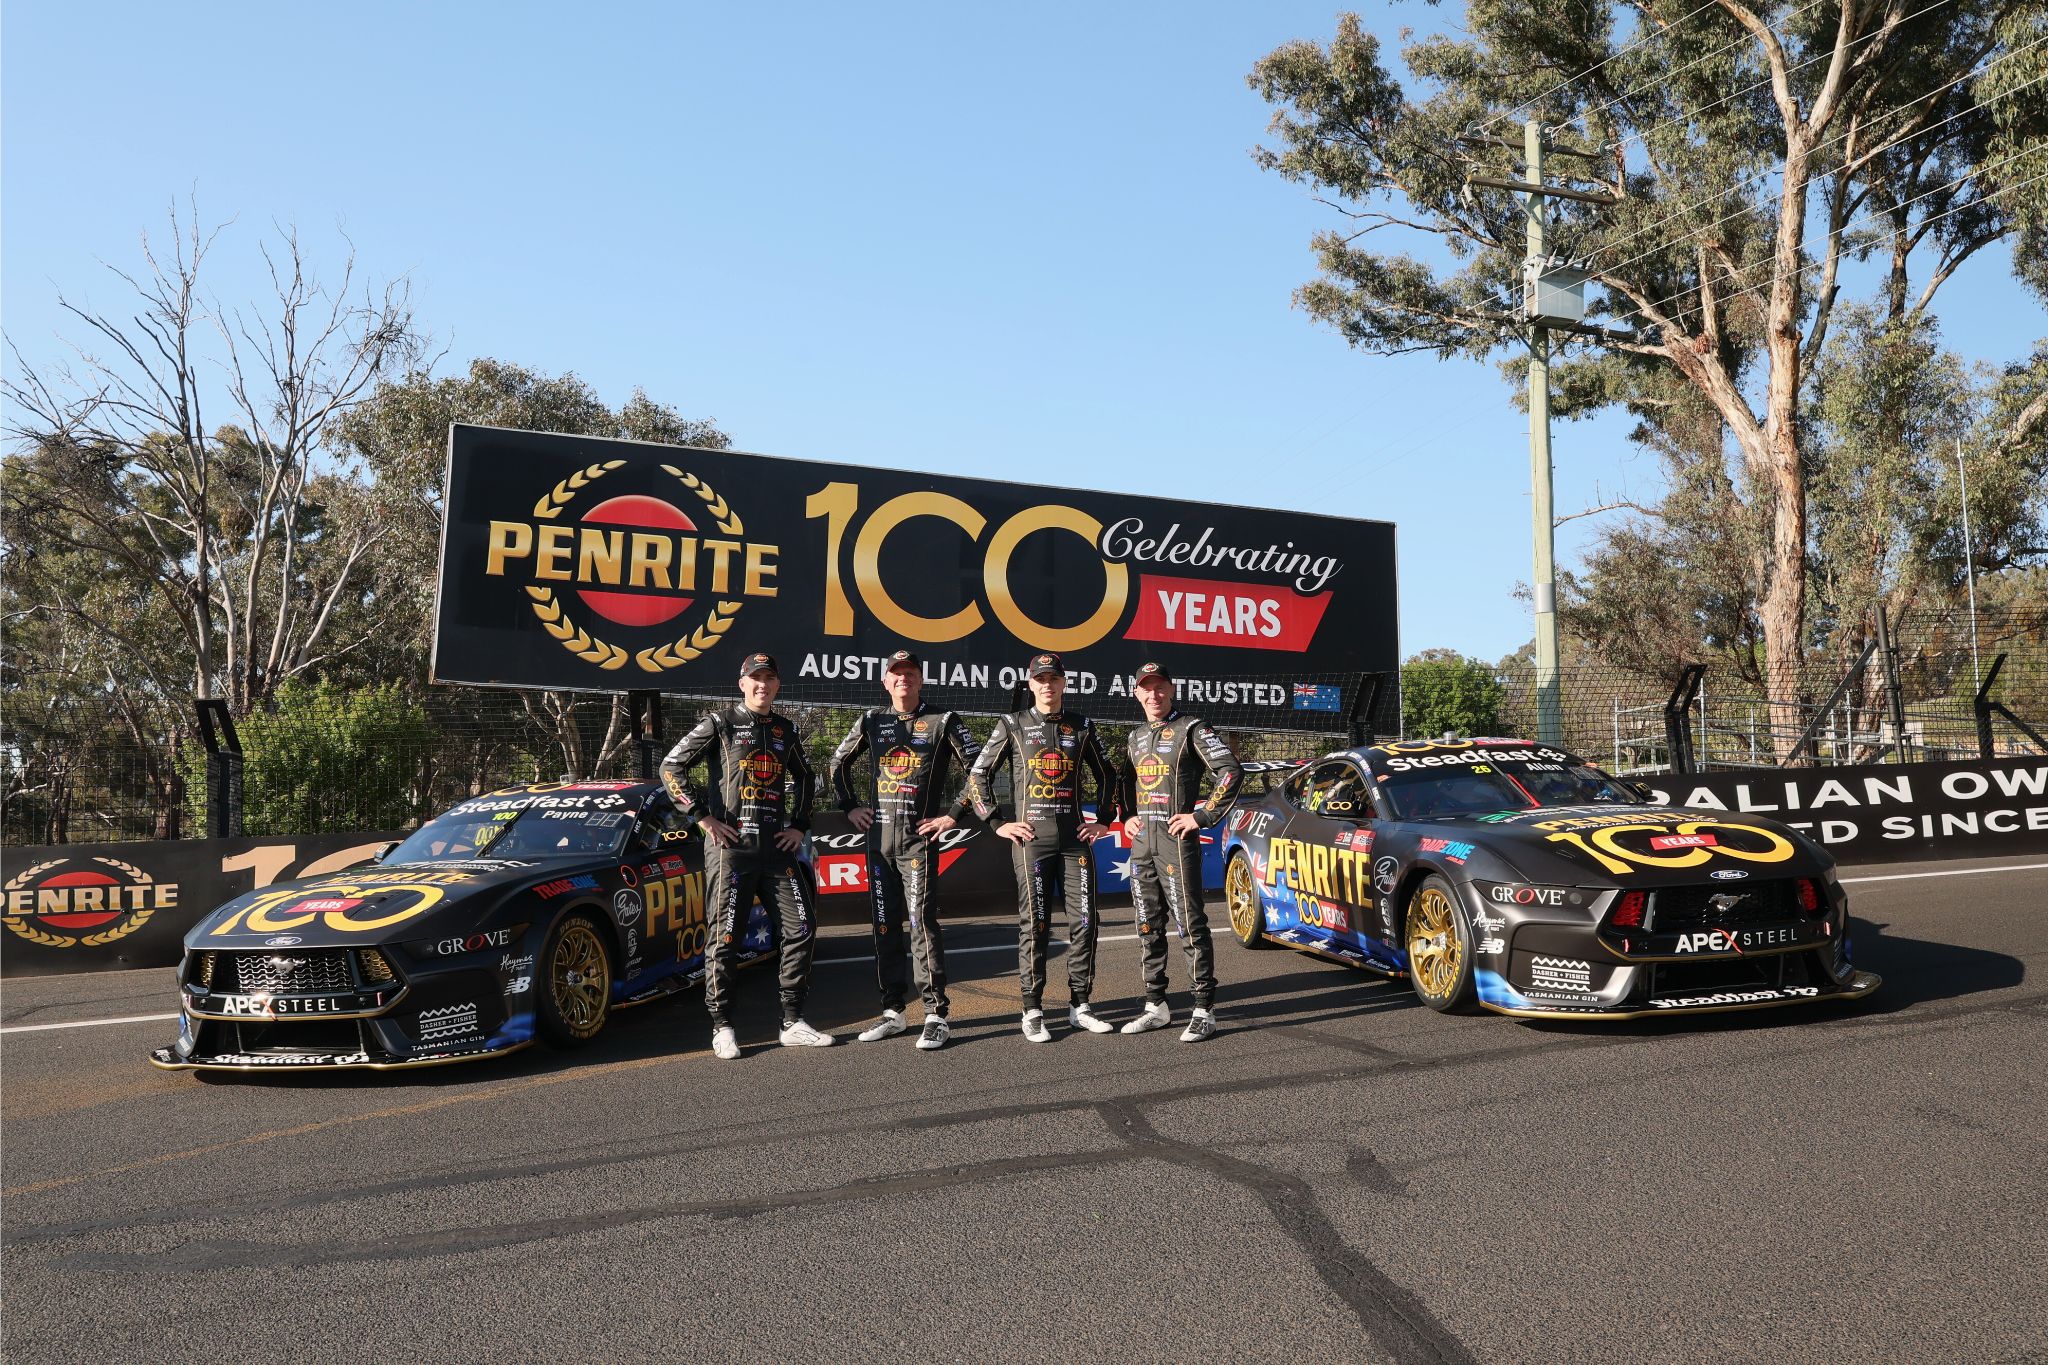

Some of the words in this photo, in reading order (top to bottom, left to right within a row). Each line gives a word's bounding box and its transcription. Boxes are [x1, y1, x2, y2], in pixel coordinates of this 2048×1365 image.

[485, 520, 779, 597] PENRITE
[1102, 517, 1343, 592] Celebrating
[806, 481, 1129, 652] 100
[1157, 590, 1282, 638] YEARS
[799, 653, 988, 688] AUSTLIAN
[998, 666, 1098, 695] OED
[1172, 677, 1286, 706] TRUSTED
[879, 756, 922, 768] PENRITE
[1027, 758, 1074, 771] PENRITE
[1386, 749, 1540, 772] Steadfast
[1471, 765, 1492, 774] 26
[1525, 762, 1564, 771] Allen
[1309, 790, 1323, 812] 26
[1650, 776, 1913, 813] ALIAN
[450, 795, 592, 817] Steadfast
[492, 811, 518, 821] 100
[541, 810, 588, 821] Payne
[1326, 801, 1352, 811] 100
[1229, 809, 1272, 838] GROVE
[1565, 820, 1629, 832] AUSTRALIAN
[1881, 806, 2048, 840] SINCE
[661, 830, 688, 841] 100
[1659, 836, 1706, 847] YEARS
[1417, 837, 1476, 861] TRADEZONE
[1544, 822, 1795, 875] 100
[1265, 837, 1374, 909] PENRITE
[730, 888, 738, 906] 1926
[790, 878, 802, 900] SINCE
[797, 901, 808, 921] 1926
[875, 879, 883, 899] 1926
[1168, 876, 1178, 902] SINCE
[1492, 886, 1563, 906] GROVE
[209, 885, 444, 935] 100
[304, 901, 345, 911] YEARS
[878, 900, 886, 923] SINCE
[1137, 896, 1147, 922] SINCE
[1294, 891, 1323, 928] 100
[726, 904, 735, 933] SINCE
[1321, 906, 1347, 929] YEARS
[1472, 912, 1506, 932] Haymes
[437, 929, 509, 955] GROVE
[1675, 930, 1741, 954] APEX
[1743, 928, 1798, 946] STEEL
[500, 953, 533, 973] Haymes
[1532, 968, 1558, 978] DASHER
[1565, 972, 1590, 981] FISHER
[223, 995, 274, 1016] APEX
[279, 998, 340, 1013] STEEL
[1523, 991, 1580, 1001] TASMANIAN
[420, 1020, 447, 1030] DASHER
[453, 1014, 477, 1024] FISHER
[411, 1038, 467, 1051] TASMANIAN
